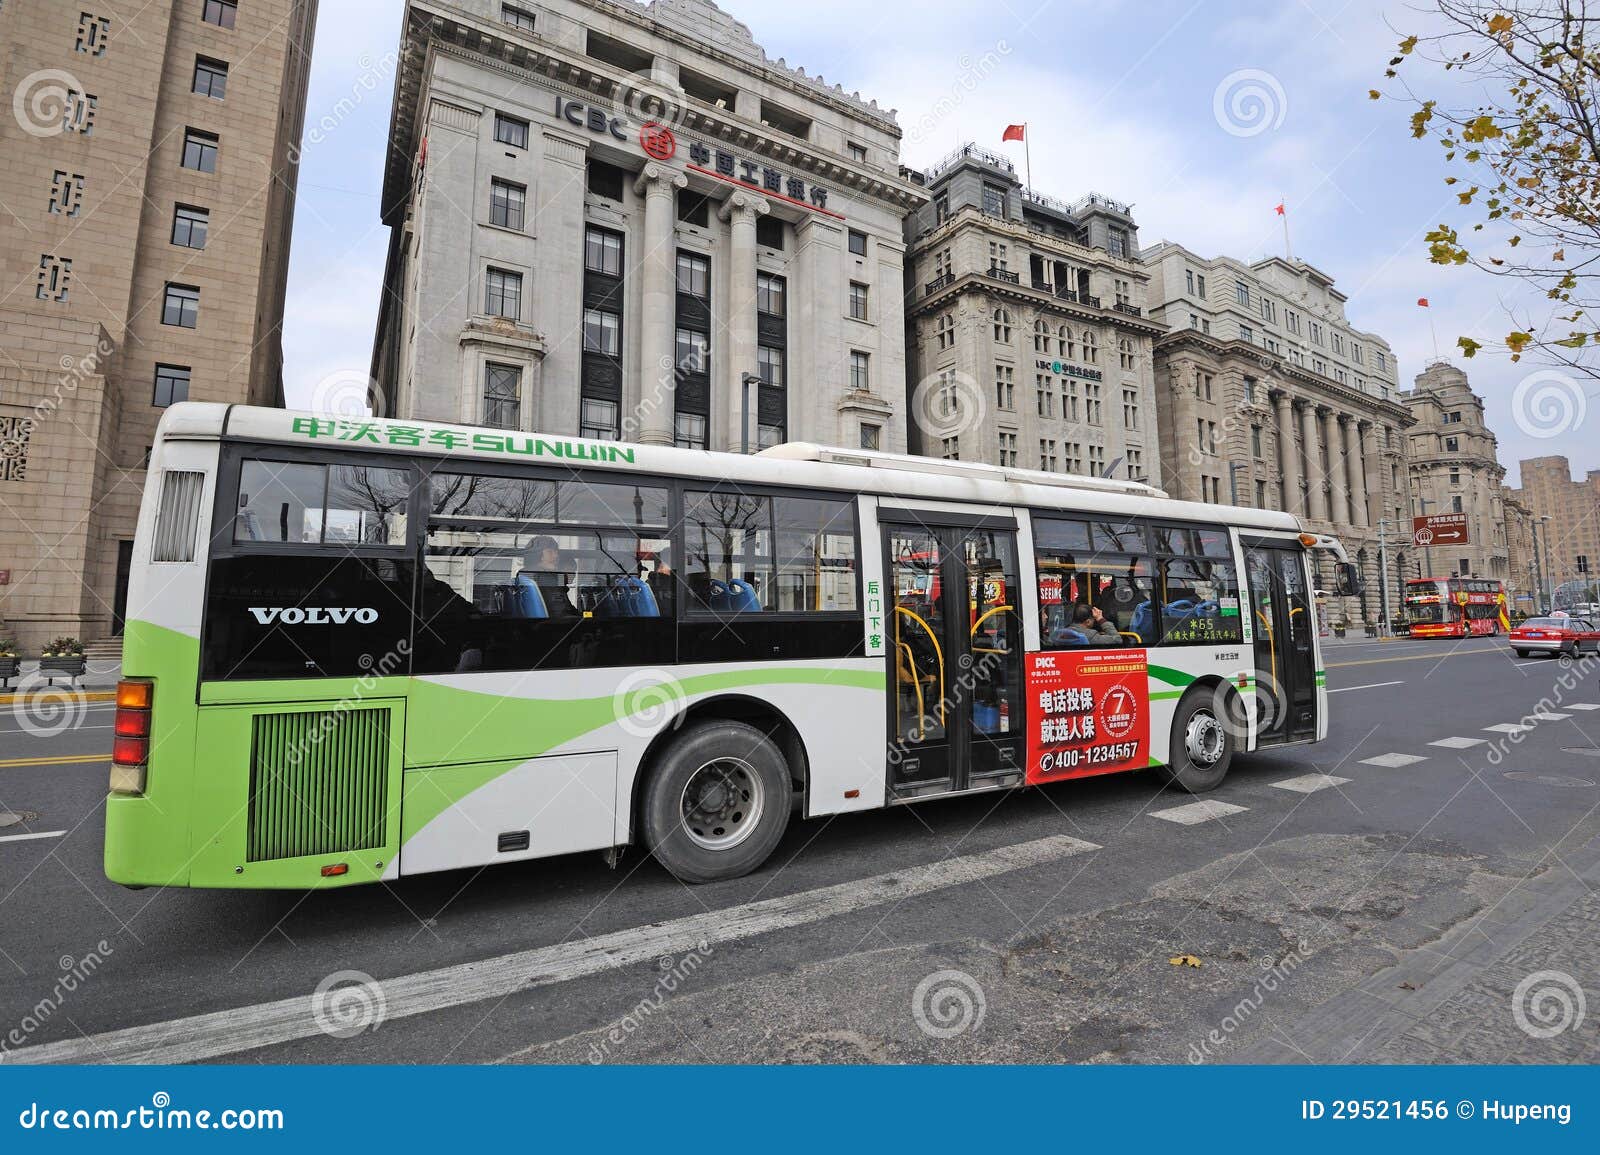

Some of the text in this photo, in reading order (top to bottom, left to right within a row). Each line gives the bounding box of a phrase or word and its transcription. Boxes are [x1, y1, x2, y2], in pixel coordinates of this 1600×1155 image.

[555, 96, 628, 142] ICBC
[689, 141, 829, 209] 中国工商银行
[291, 416, 636, 464] 申沃客车 SUNWIN
[247, 607, 379, 625] VOLVO
[867, 581, 882, 649] 后门下客
[1035, 656, 1056, 668] PICC
[1039, 687, 1094, 714] 电话投保
[1040, 715, 1095, 744] 就选人保
[1055, 741, 1138, 768] 400-1234567
